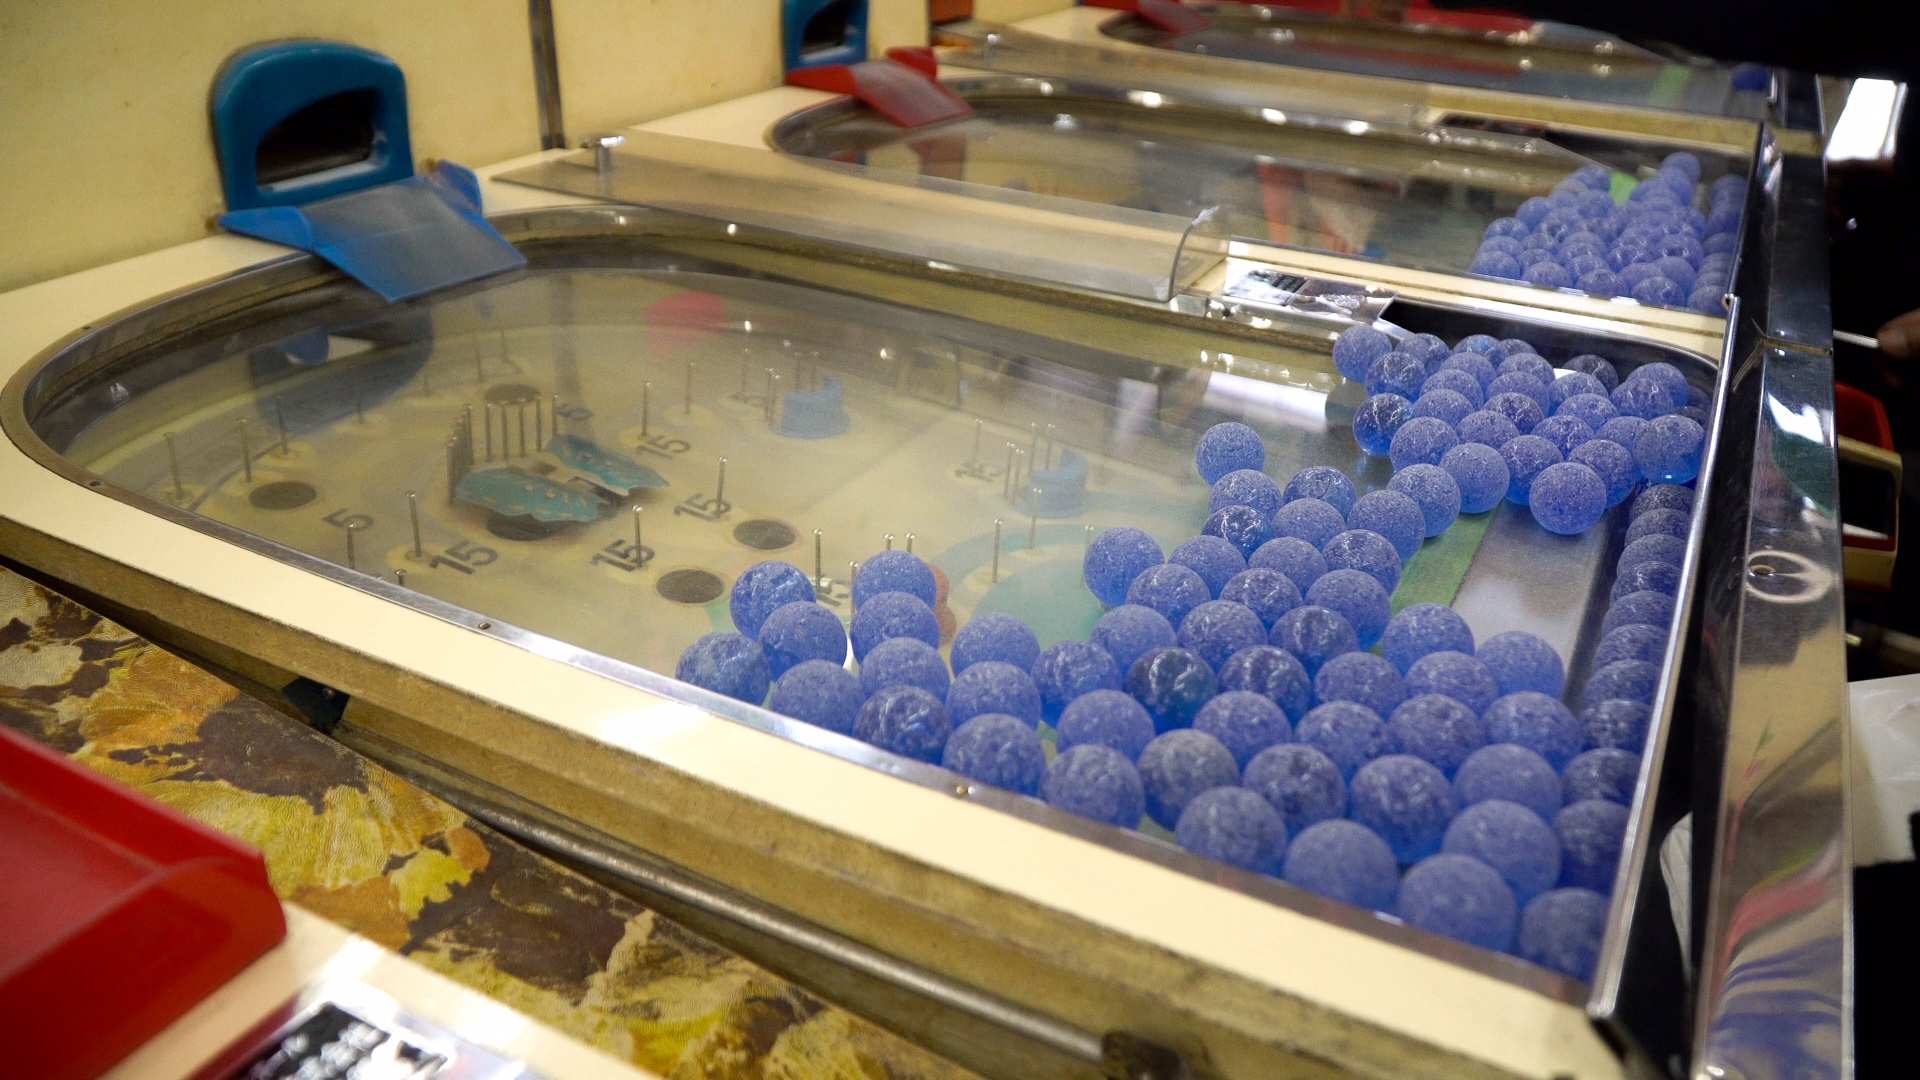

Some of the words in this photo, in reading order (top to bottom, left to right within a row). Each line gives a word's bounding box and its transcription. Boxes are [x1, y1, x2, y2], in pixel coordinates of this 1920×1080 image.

[637, 435, 690, 460] 15
[322, 507, 375, 532] 5
[673, 493, 731, 521] 15
[430, 540, 498, 575] 15
[591, 539, 655, 572] 15
